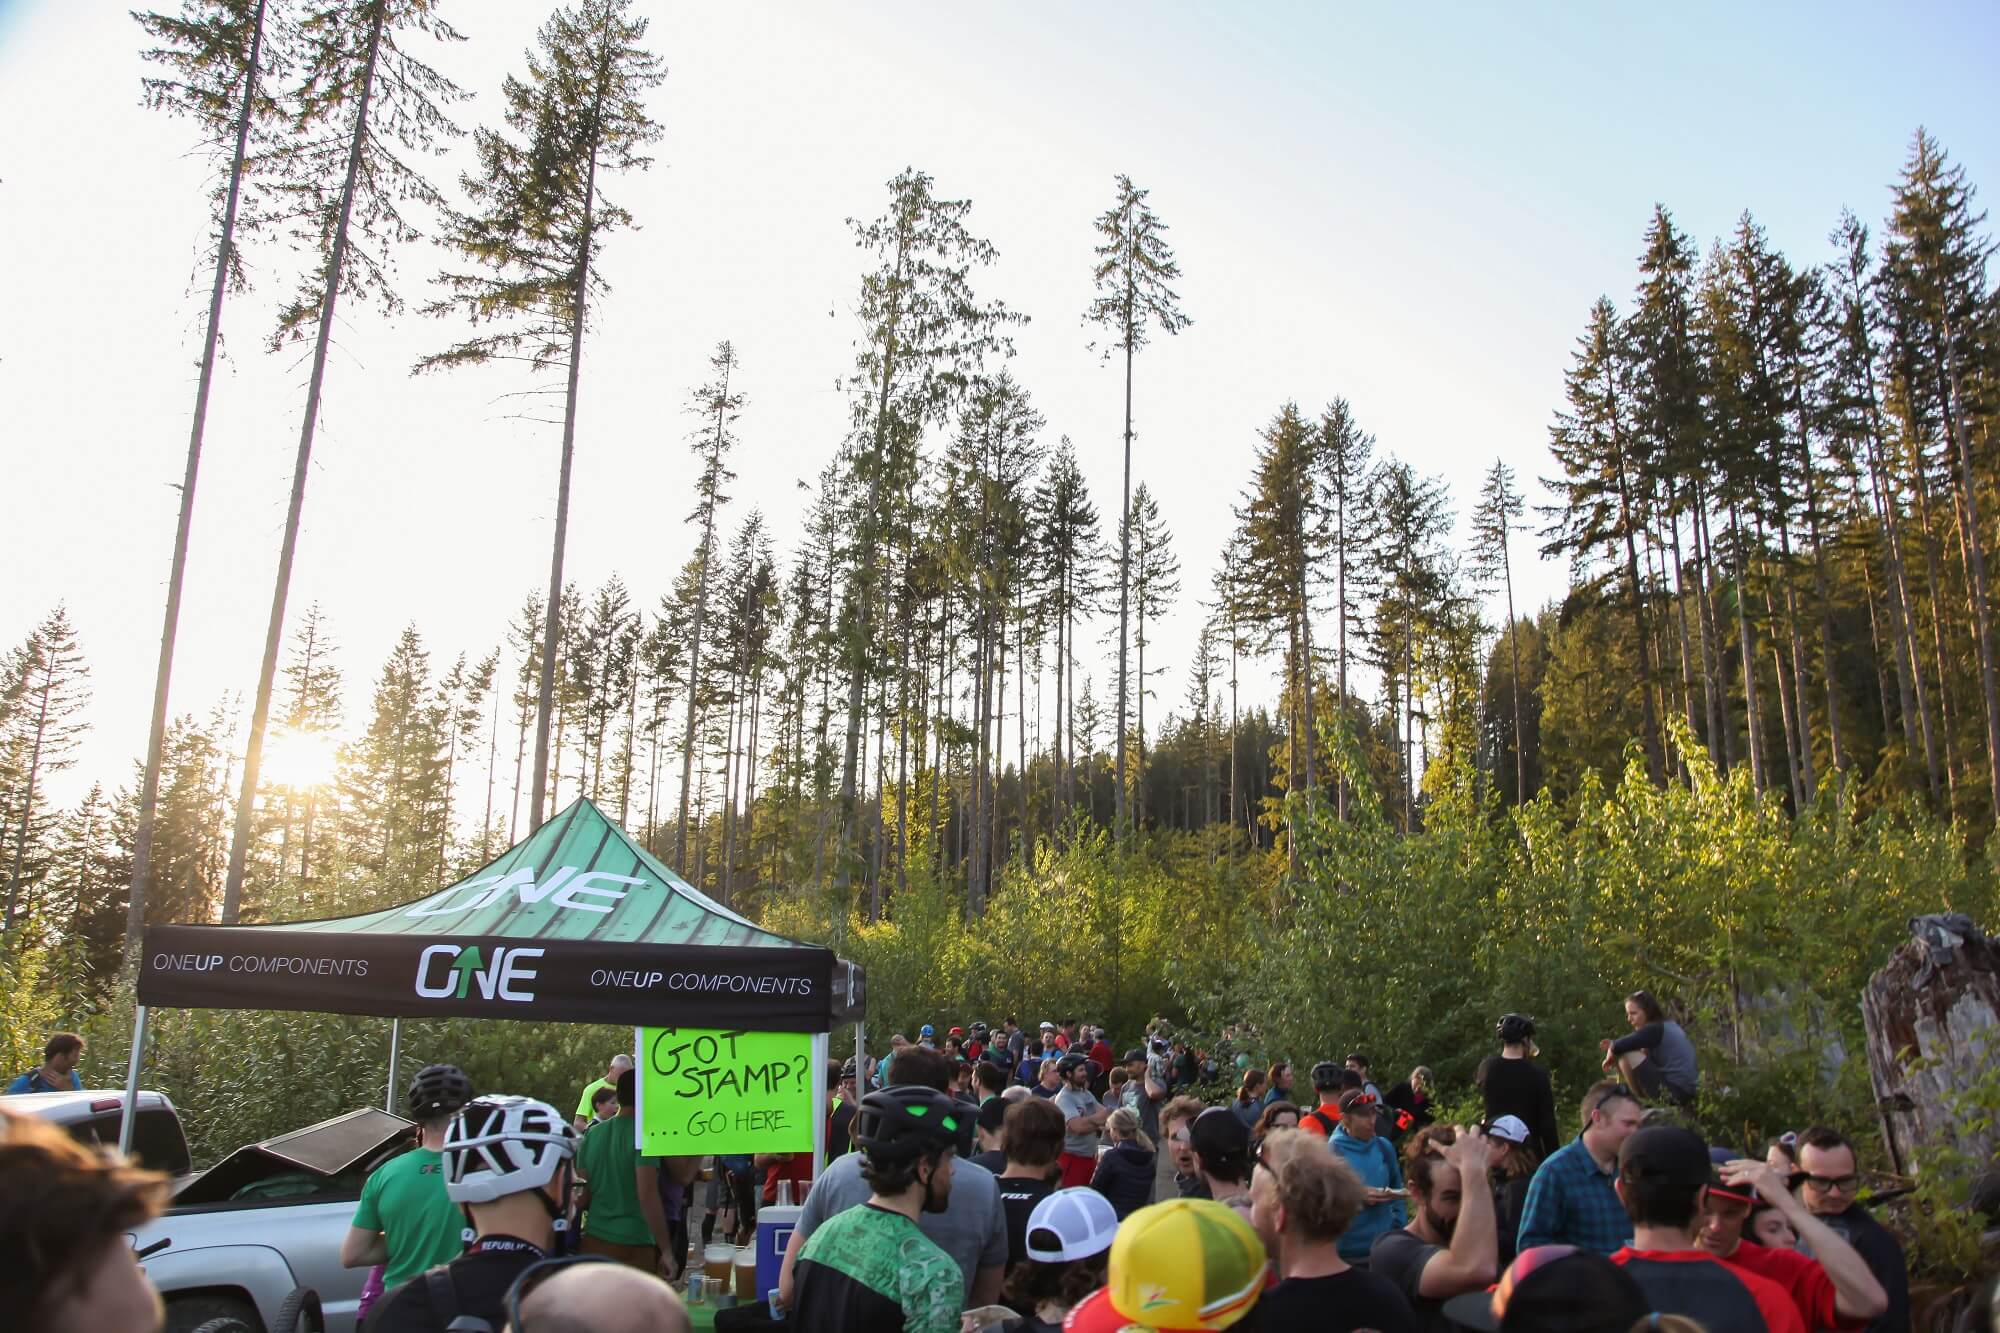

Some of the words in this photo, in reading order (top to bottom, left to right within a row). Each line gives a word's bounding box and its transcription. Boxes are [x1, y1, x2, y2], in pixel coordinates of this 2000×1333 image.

[405, 866, 647, 913] ONE
[153, 953, 223, 971] ONEUP
[229, 955, 369, 976] COMPONENTS
[415, 944, 545, 1001] ONE
[591, 969, 663, 988] ONEUP
[668, 972, 812, 995] COMPONENTS
[652, 1028, 746, 1076] GOT
[674, 1054, 808, 1099] STAMP?
[736, 1110, 791, 1132] HERE
